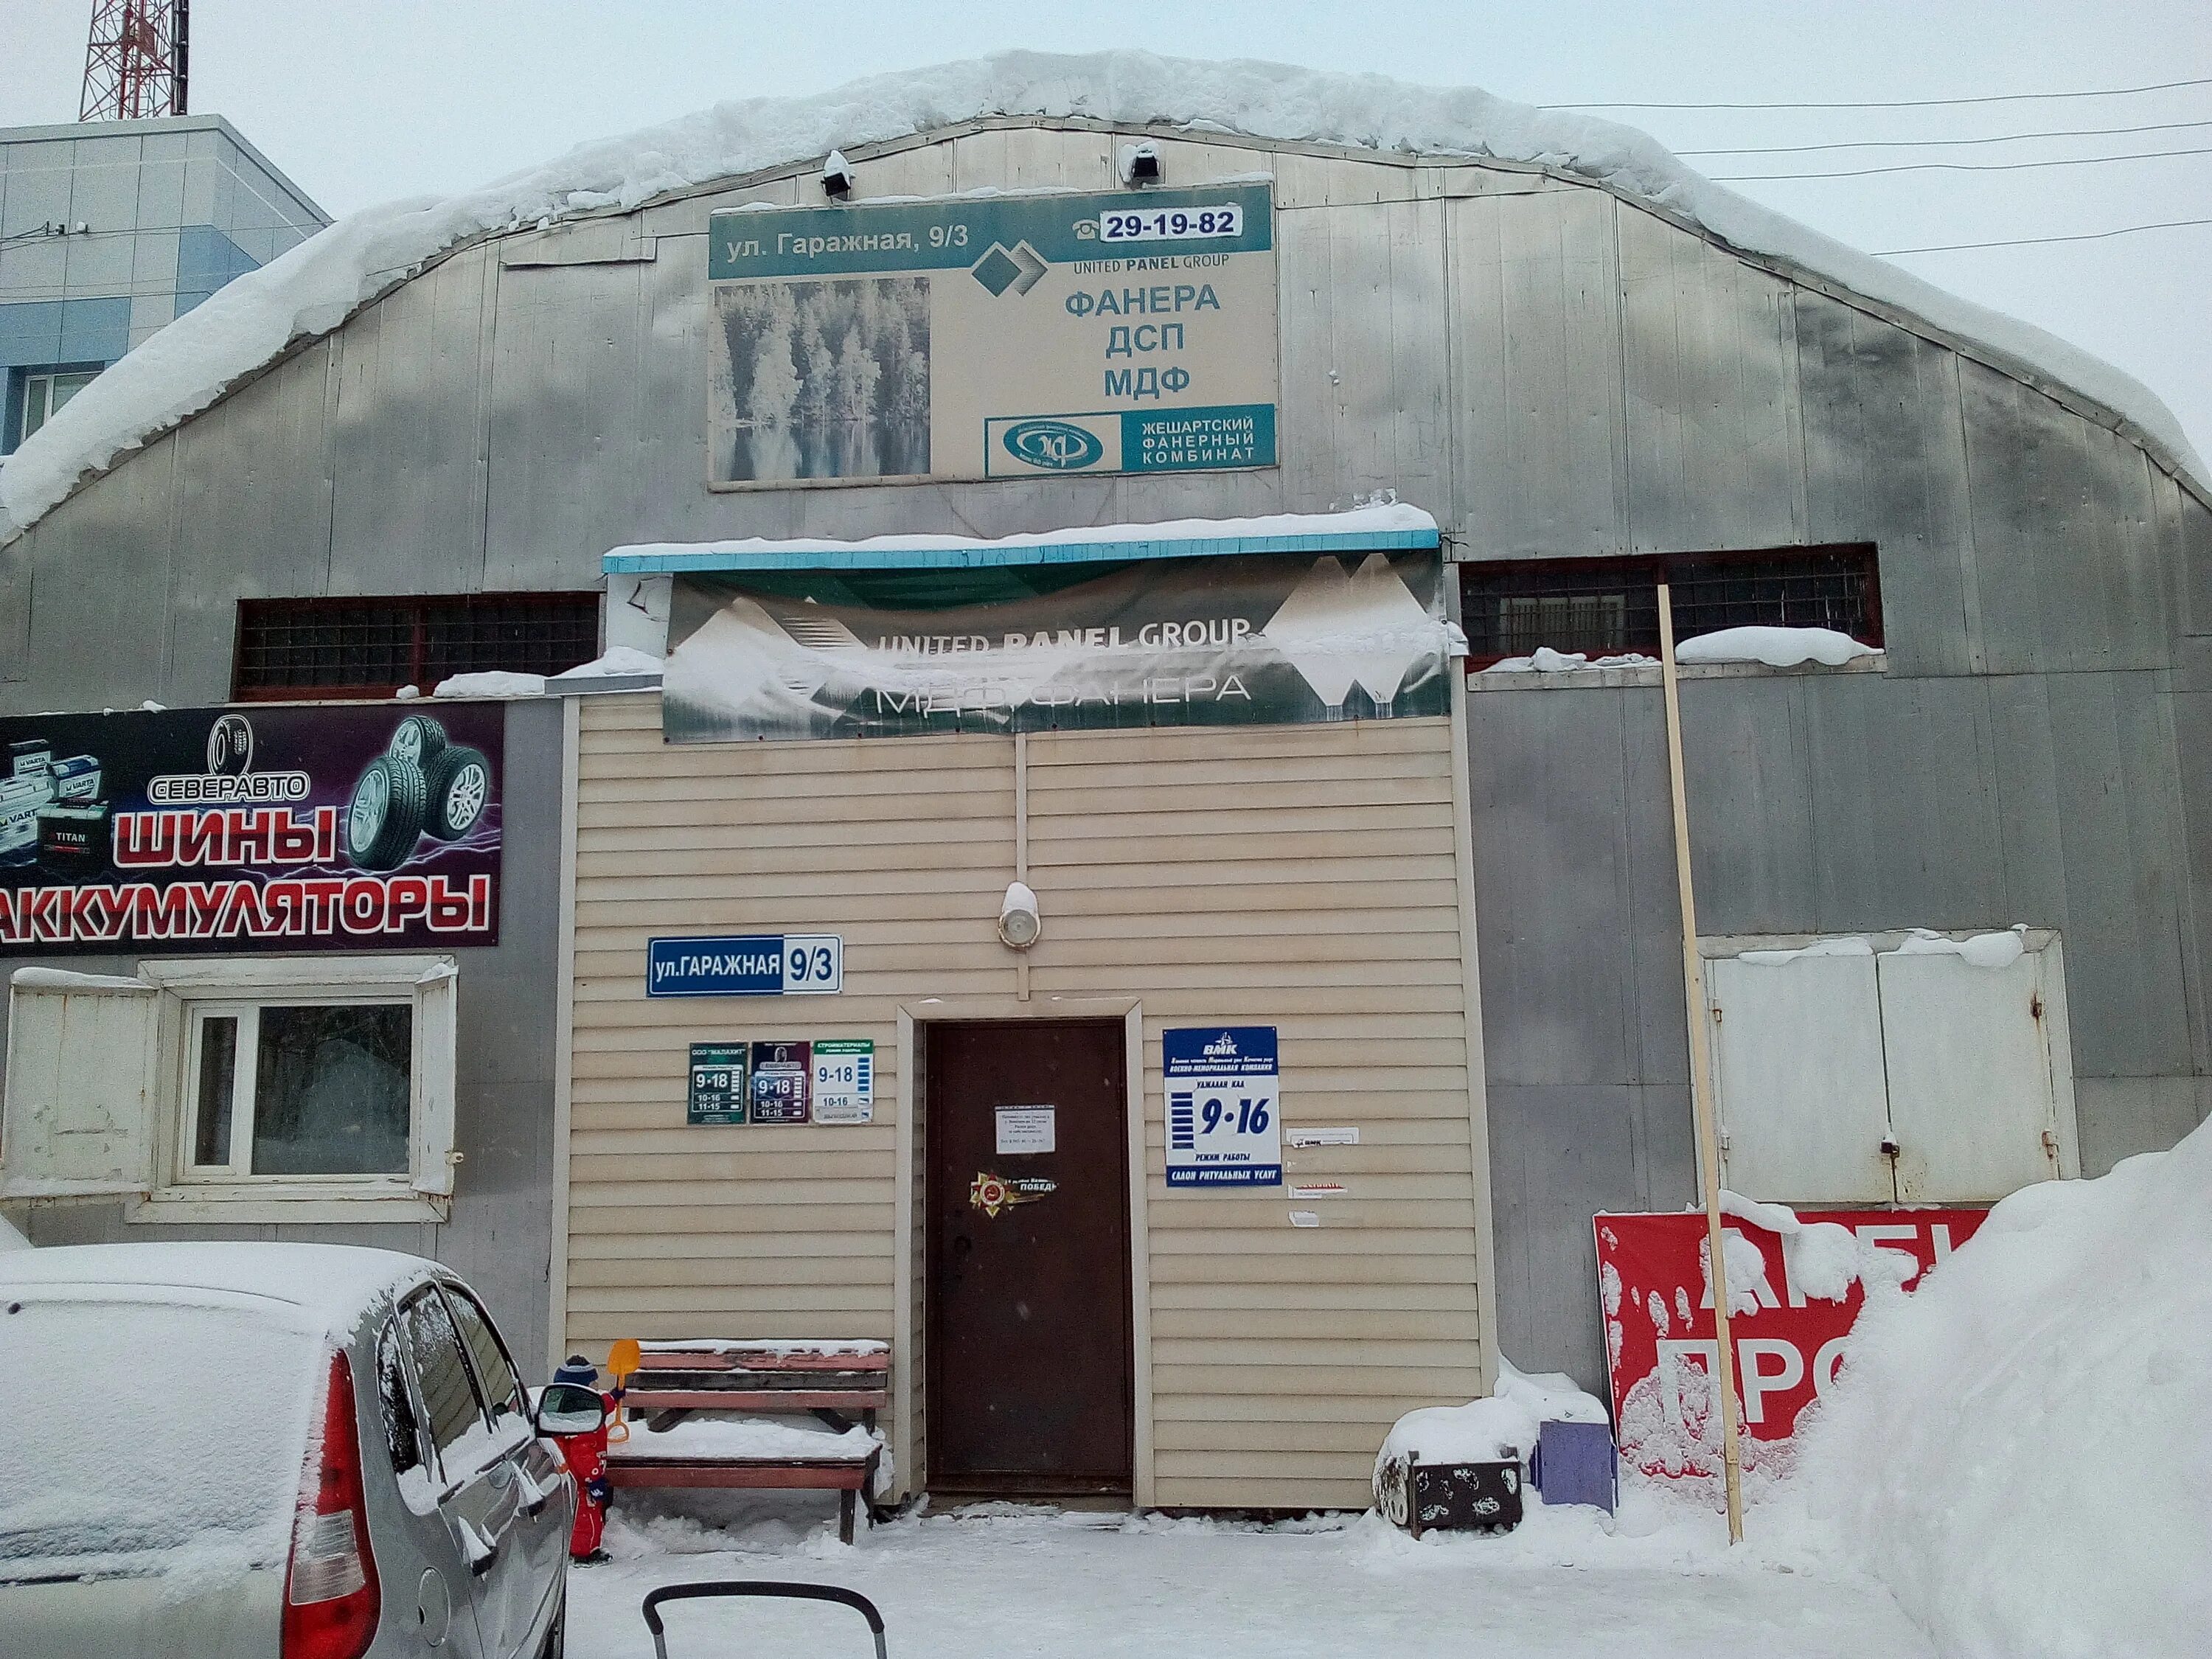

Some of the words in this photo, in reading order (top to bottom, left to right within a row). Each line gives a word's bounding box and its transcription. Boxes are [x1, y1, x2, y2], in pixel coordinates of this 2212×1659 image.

[1106, 211, 1235, 237] 29-19-82
[727, 239, 767, 263] ул.
[776, 232, 919, 258] Гаражная,
[928, 224, 969, 248] 9/3
[1074, 260, 1121, 275] UNITED
[1126, 256, 1180, 272] PANEL
[1183, 254, 1230, 268] GROUP
[1065, 283, 1221, 318] ФАНЕРА
[1105, 322, 1185, 359] ДСП
[1105, 366, 1190, 400] МДФ
[1142, 415, 1253, 436] ЖЕШАРТСКИЙ
[1142, 431, 1253, 449] ФАНЕРНЫЙ
[1142, 447, 1254, 465] КОМБИНАТ
[1138, 617, 1252, 648] GROUP
[150, 772, 309, 802] СЕВЕРАВТО
[55, 832, 86, 842] TITAN
[113, 805, 338, 868] ШИНЫ
[790, 946, 832, 982] 9/3
[1203, 1044, 1238, 1055] ВМК
[818, 1066, 852, 1083] 9-18
[824, 1096, 848, 1106] 10-16
[1194, 1153, 1220, 1162] РЕЖИМ
[1222, 1153, 1251, 1161] РАБОТЫ
[1171, 1171, 1196, 1180] САЛОН
[1199, 1170, 1251, 1180] РИТУАЛЬНЫХ
[1254, 1169, 1277, 1179] УСЛУГ
